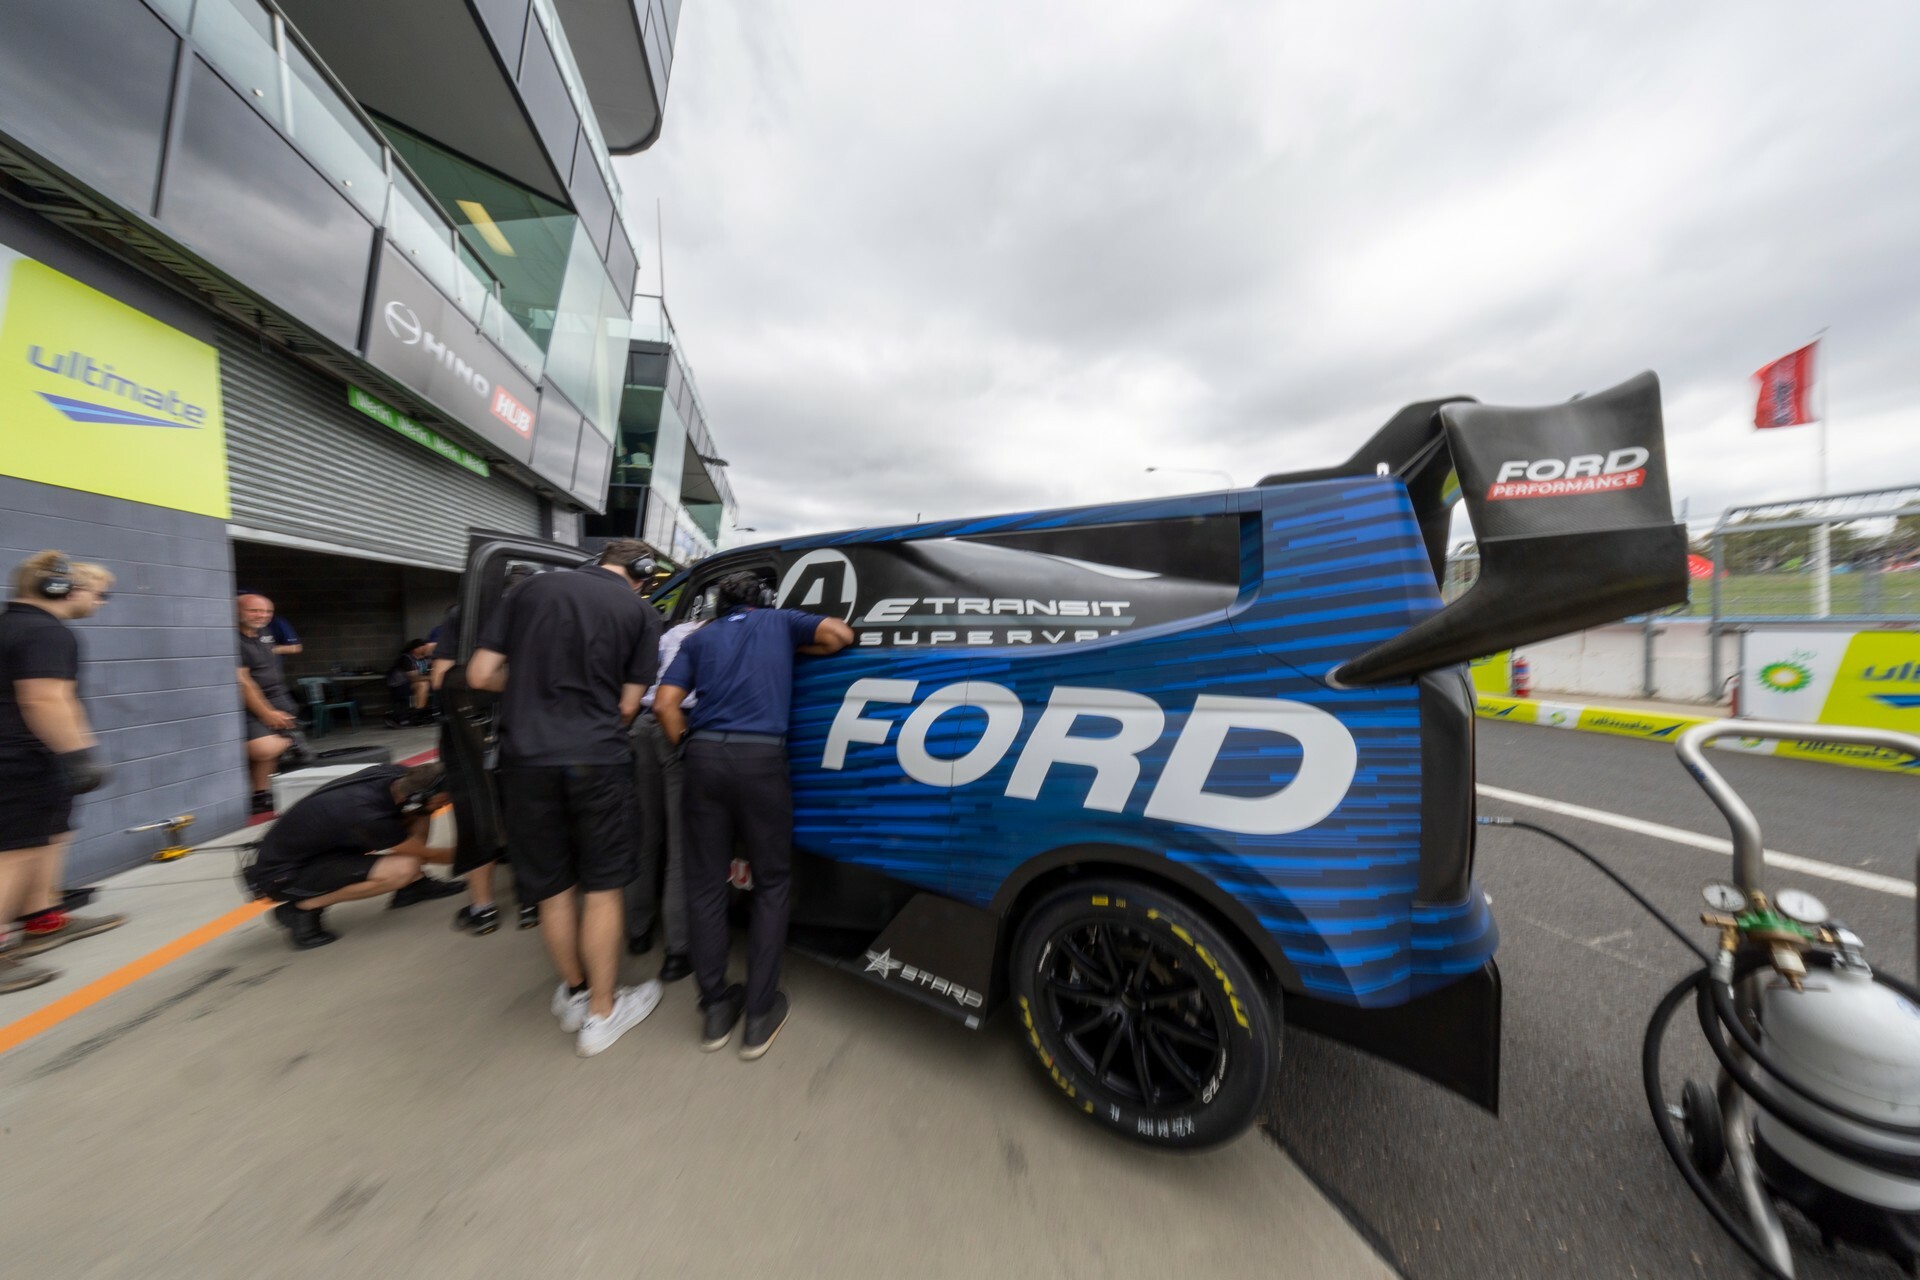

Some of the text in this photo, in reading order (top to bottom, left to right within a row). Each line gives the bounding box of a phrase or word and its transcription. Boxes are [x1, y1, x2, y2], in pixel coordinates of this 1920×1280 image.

[27, 344, 207, 425] ultimate
[423, 331, 531, 432] HINO HUB
[1496, 446, 1650, 484] FORD
[1492, 471, 1640, 498] PERFORMANCE
[922, 597, 1131, 617] TRANSIT
[859, 630, 1120, 646] SUPERVA
[821, 677, 1358, 836] FORD
